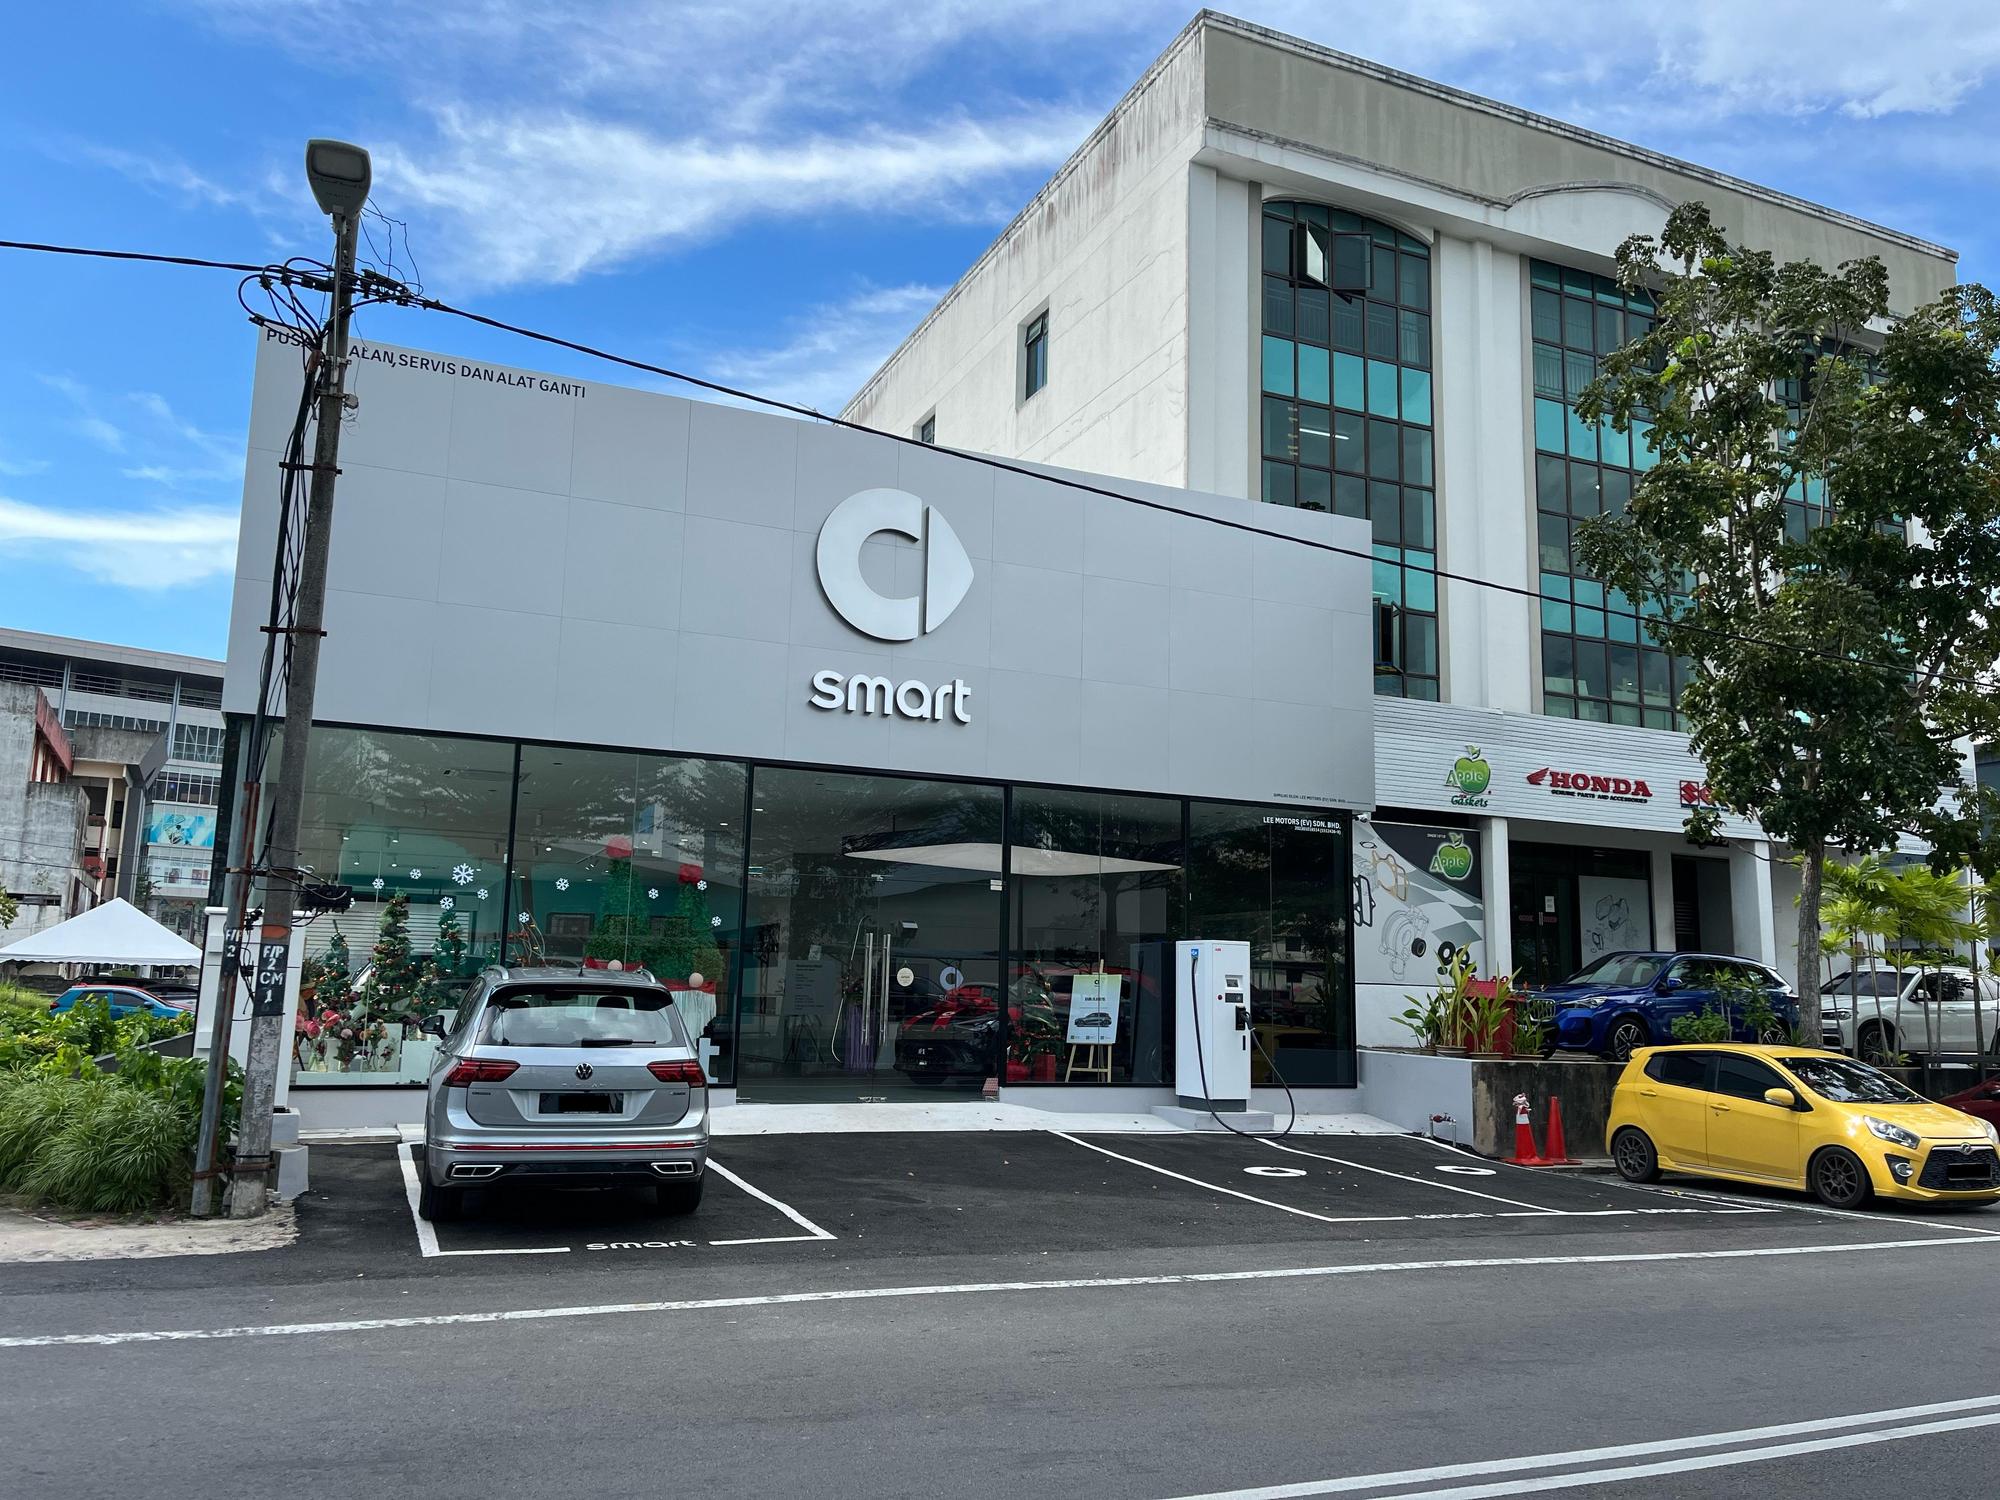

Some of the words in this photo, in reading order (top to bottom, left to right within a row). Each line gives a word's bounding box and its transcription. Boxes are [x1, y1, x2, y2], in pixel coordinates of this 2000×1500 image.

[398, 354, 456, 375] SERVIS
[461, 365, 494, 382] DAN
[496, 372, 536, 389] ALAT
[539, 379, 586, 398] GANTI
[807, 669, 972, 726] smart
[1549, 771, 1653, 797] HONDA
[1451, 795, 1489, 808] Gaskets
[1263, 816, 1275, 824] LEE
[1275, 817, 1300, 825] MOTORS
[1300, 819, 1313, 828] (EV)
[1312, 820, 1328, 828] SDN.
[1327, 821, 1342, 830] BHD.
[227, 945, 236, 957] 2
[263, 945, 285, 958] F/P
[267, 957, 276, 970] 2
[260, 971, 284, 985] CM
[264, 989, 273, 1004] 1
[586, 1240, 697, 1250] smart
